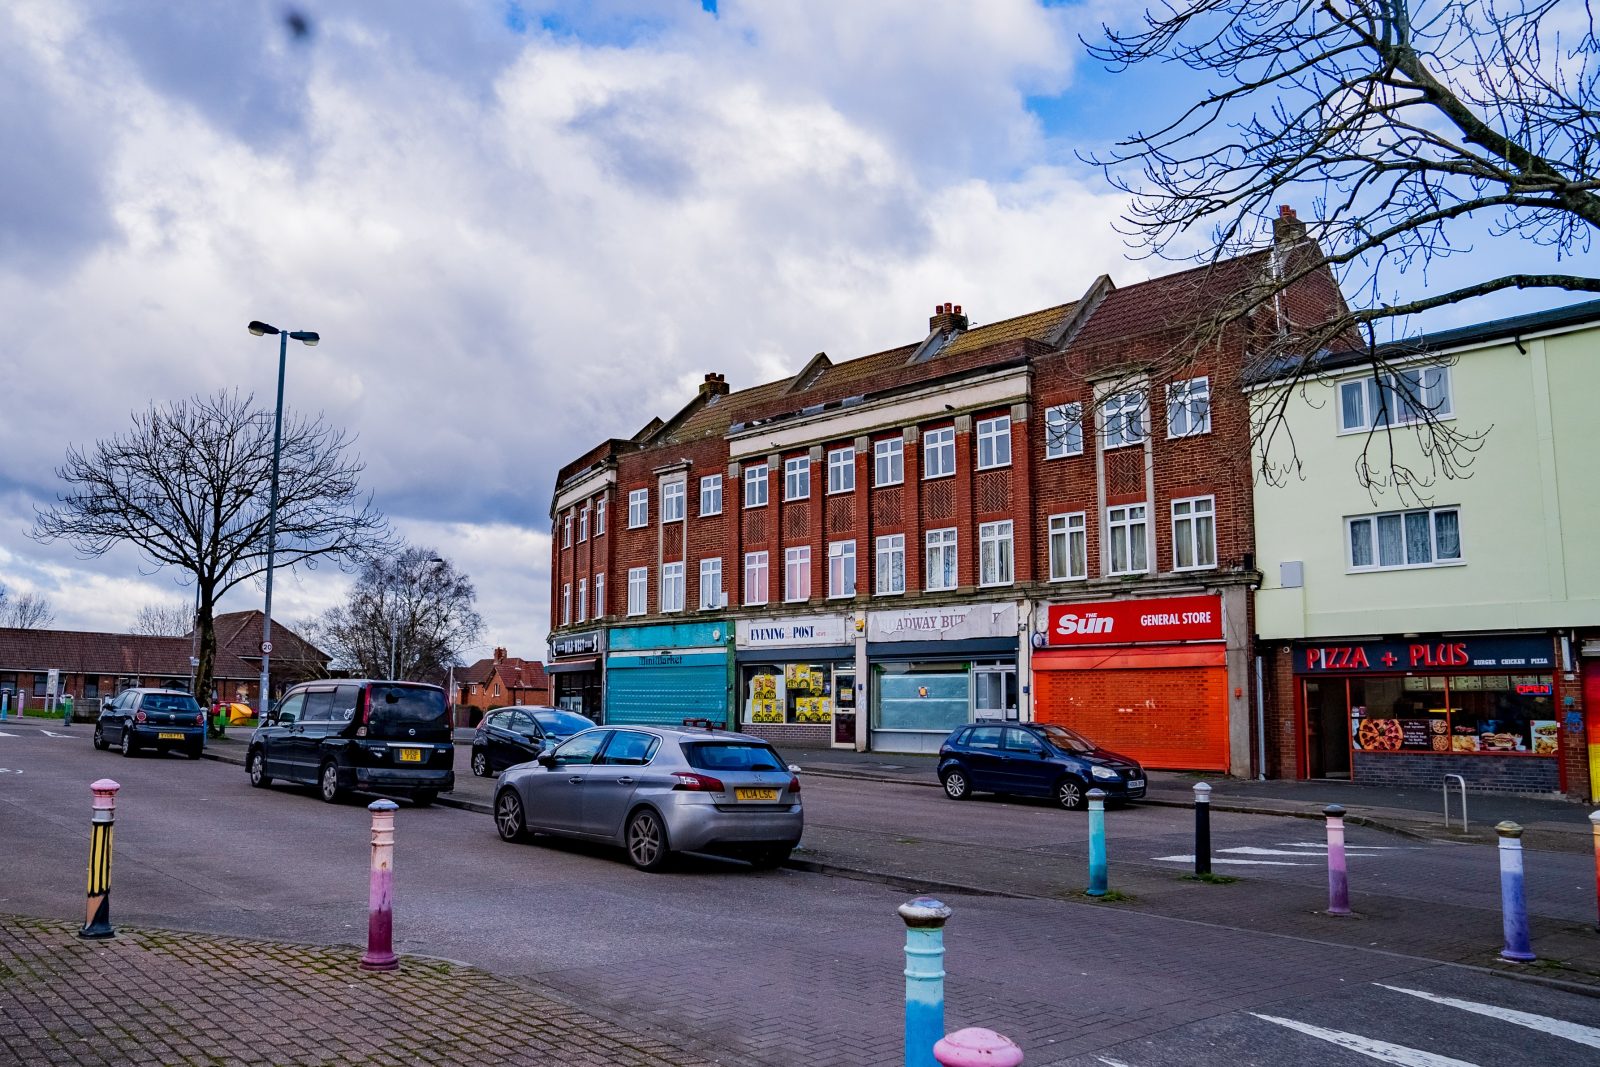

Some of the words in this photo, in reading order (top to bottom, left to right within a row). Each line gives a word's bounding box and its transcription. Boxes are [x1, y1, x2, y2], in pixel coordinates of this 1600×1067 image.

[1141, 613, 1180, 626] GENERAL
[1182, 611, 1211, 624] STORE
[750, 627, 785, 641] EVENING
[793, 626, 815, 639] POST
[1306, 646, 1370, 669] PIZZA
[1408, 643, 1469, 667] PLUS
[1516, 684, 1549, 694] OPEN
[760, 788, 773, 799] LSC
